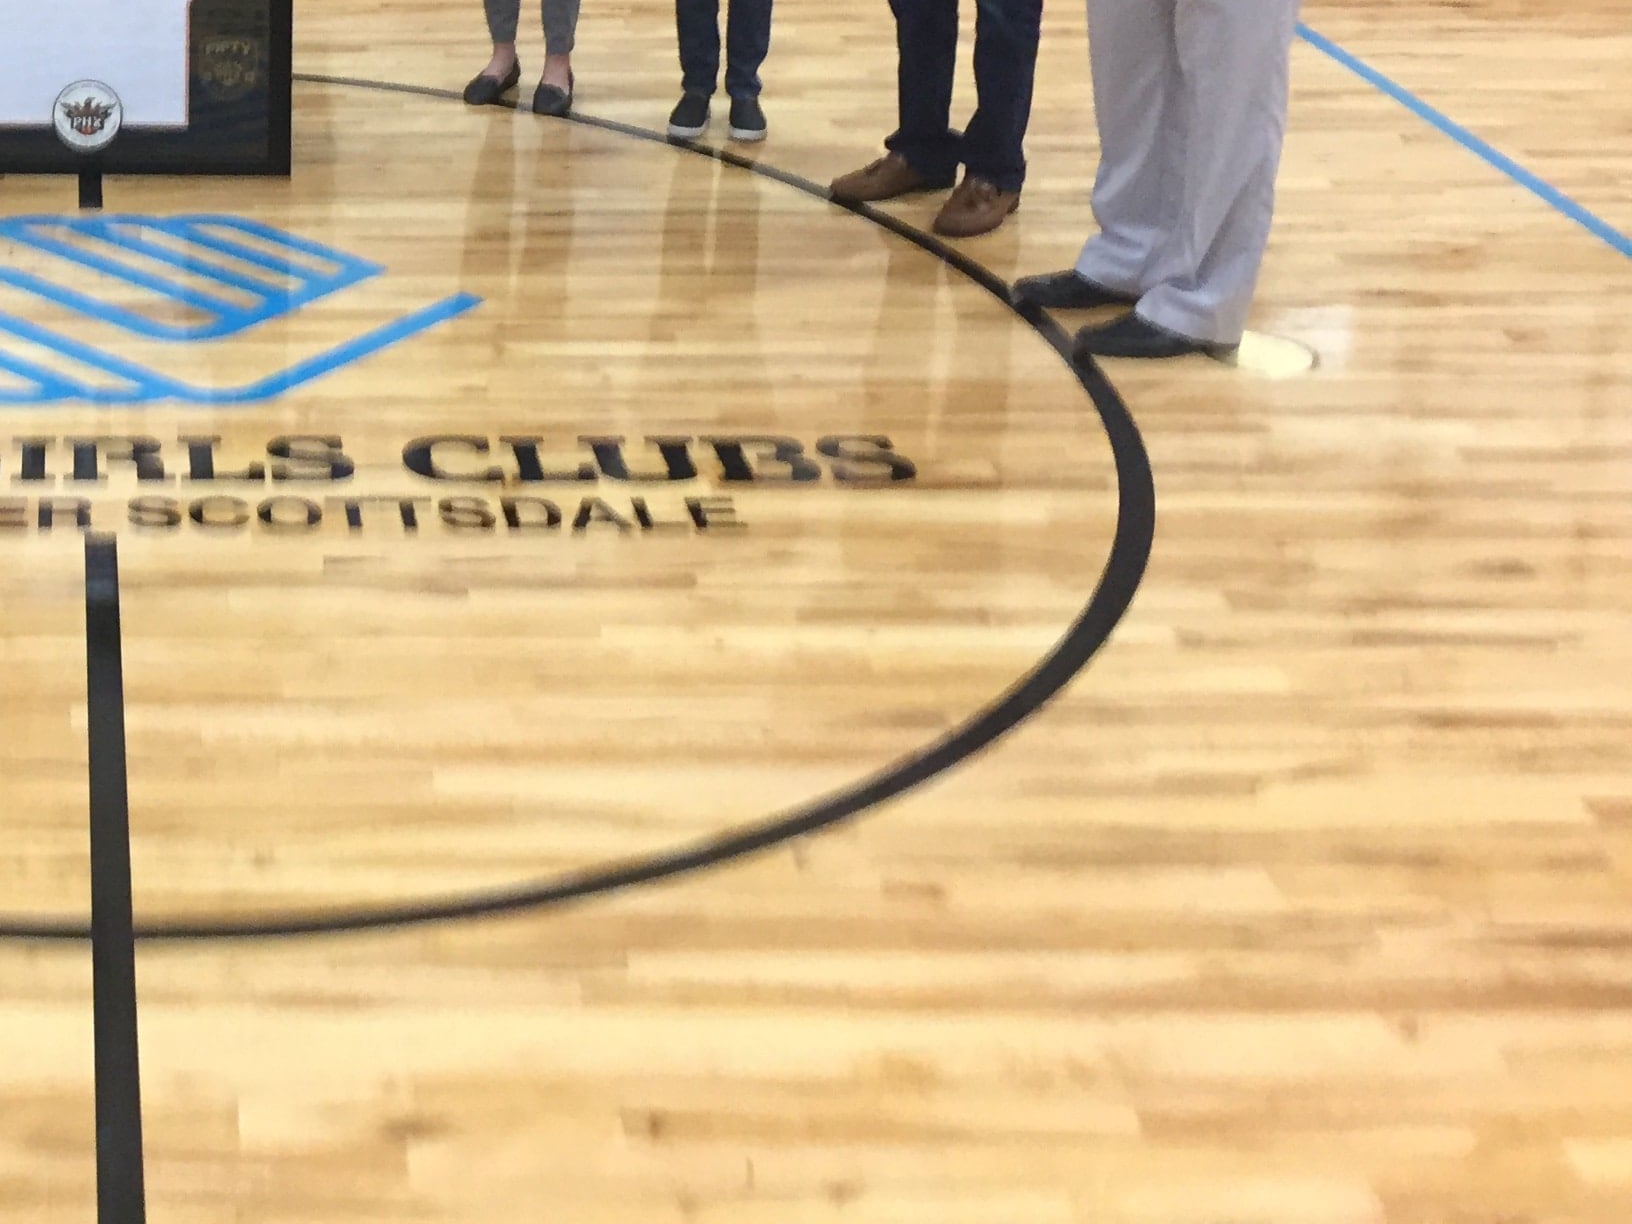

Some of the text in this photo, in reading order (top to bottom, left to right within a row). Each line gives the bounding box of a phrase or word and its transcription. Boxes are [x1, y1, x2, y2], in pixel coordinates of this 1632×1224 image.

[72, 116, 103, 130] PHX
[401, 432, 917, 488] CLUBS
[126, 493, 748, 536] SCOTTSDALE
